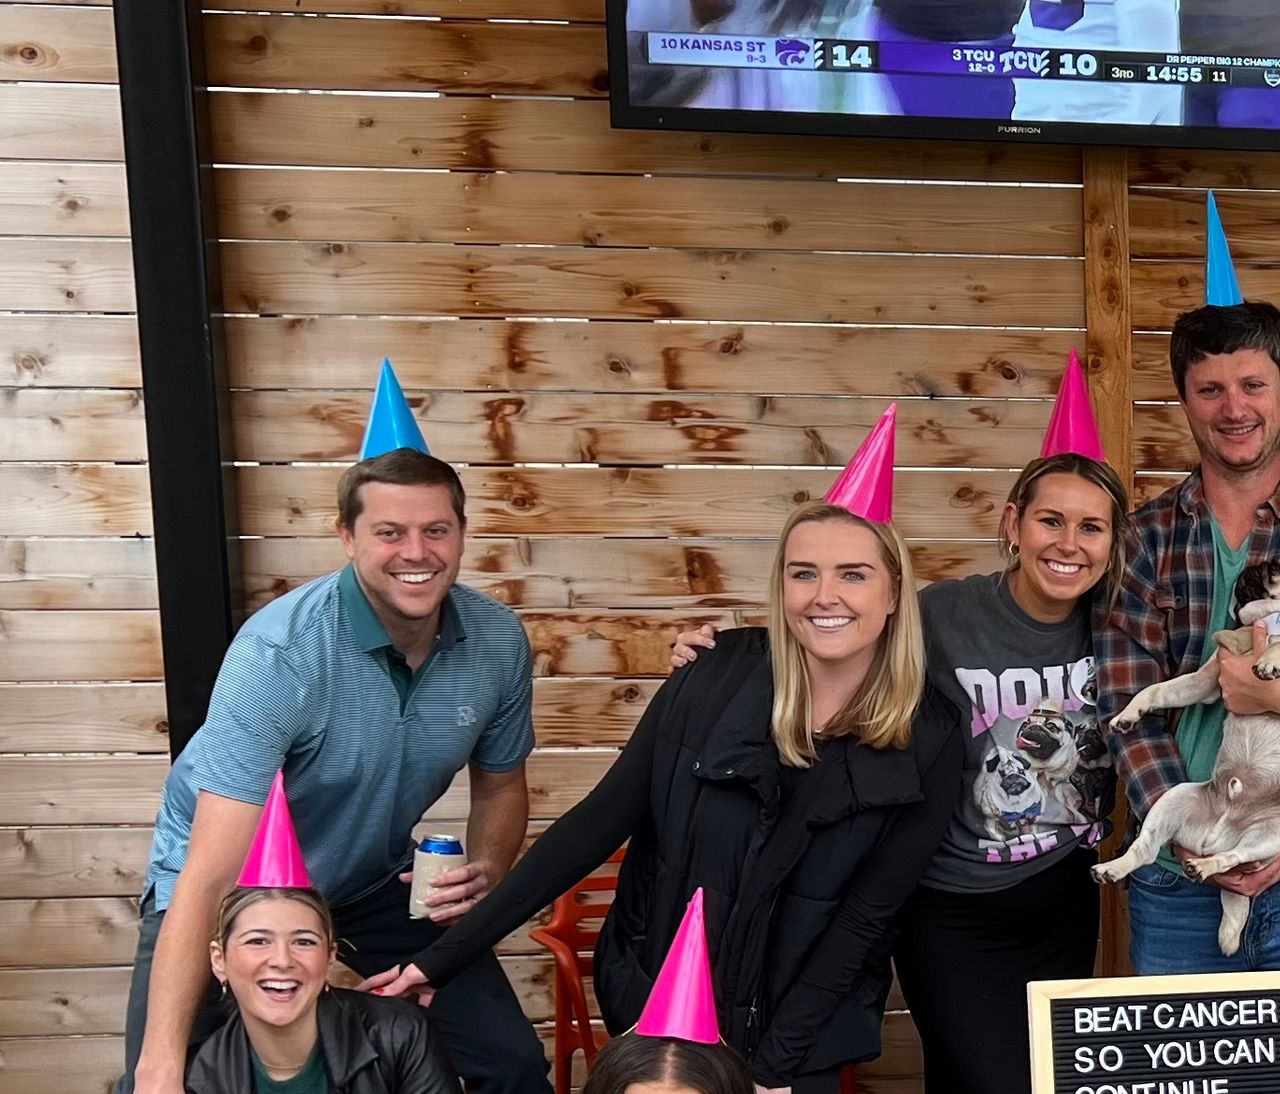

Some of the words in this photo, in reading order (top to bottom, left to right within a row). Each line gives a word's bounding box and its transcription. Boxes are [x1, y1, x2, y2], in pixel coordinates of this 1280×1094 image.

[660, 38, 678, 50] 10
[680, 38, 743, 53] KANSAS
[746, 41, 766, 53] ST
[746, 53, 767, 64] 9-3
[831, 45, 872, 68] 14
[952, 49, 962, 61] 3
[963, 49, 995, 62] TCU
[1000, 50, 1045, 74] TCU
[1166, 55, 1180, 64] DR
[1180, 55, 1216, 65] PEPPER
[1232, 57, 1243, 66] 12
[968, 62, 996, 73] 12-0
[1059, 53, 1098, 76] 10
[1111, 66, 1134, 79] 3RD
[1146, 65, 1203, 83] 14:55
[1212, 71, 1227, 82] 11
[998, 125, 1041, 134] FURRION
[1074, 1004, 1148, 1033] BEAT
[1153, 999, 1278, 1029] CANCER
[1074, 1045, 1123, 1073] SO
[1144, 1040, 1206, 1068] YOU
[1213, 1037, 1276, 1065] CAN
